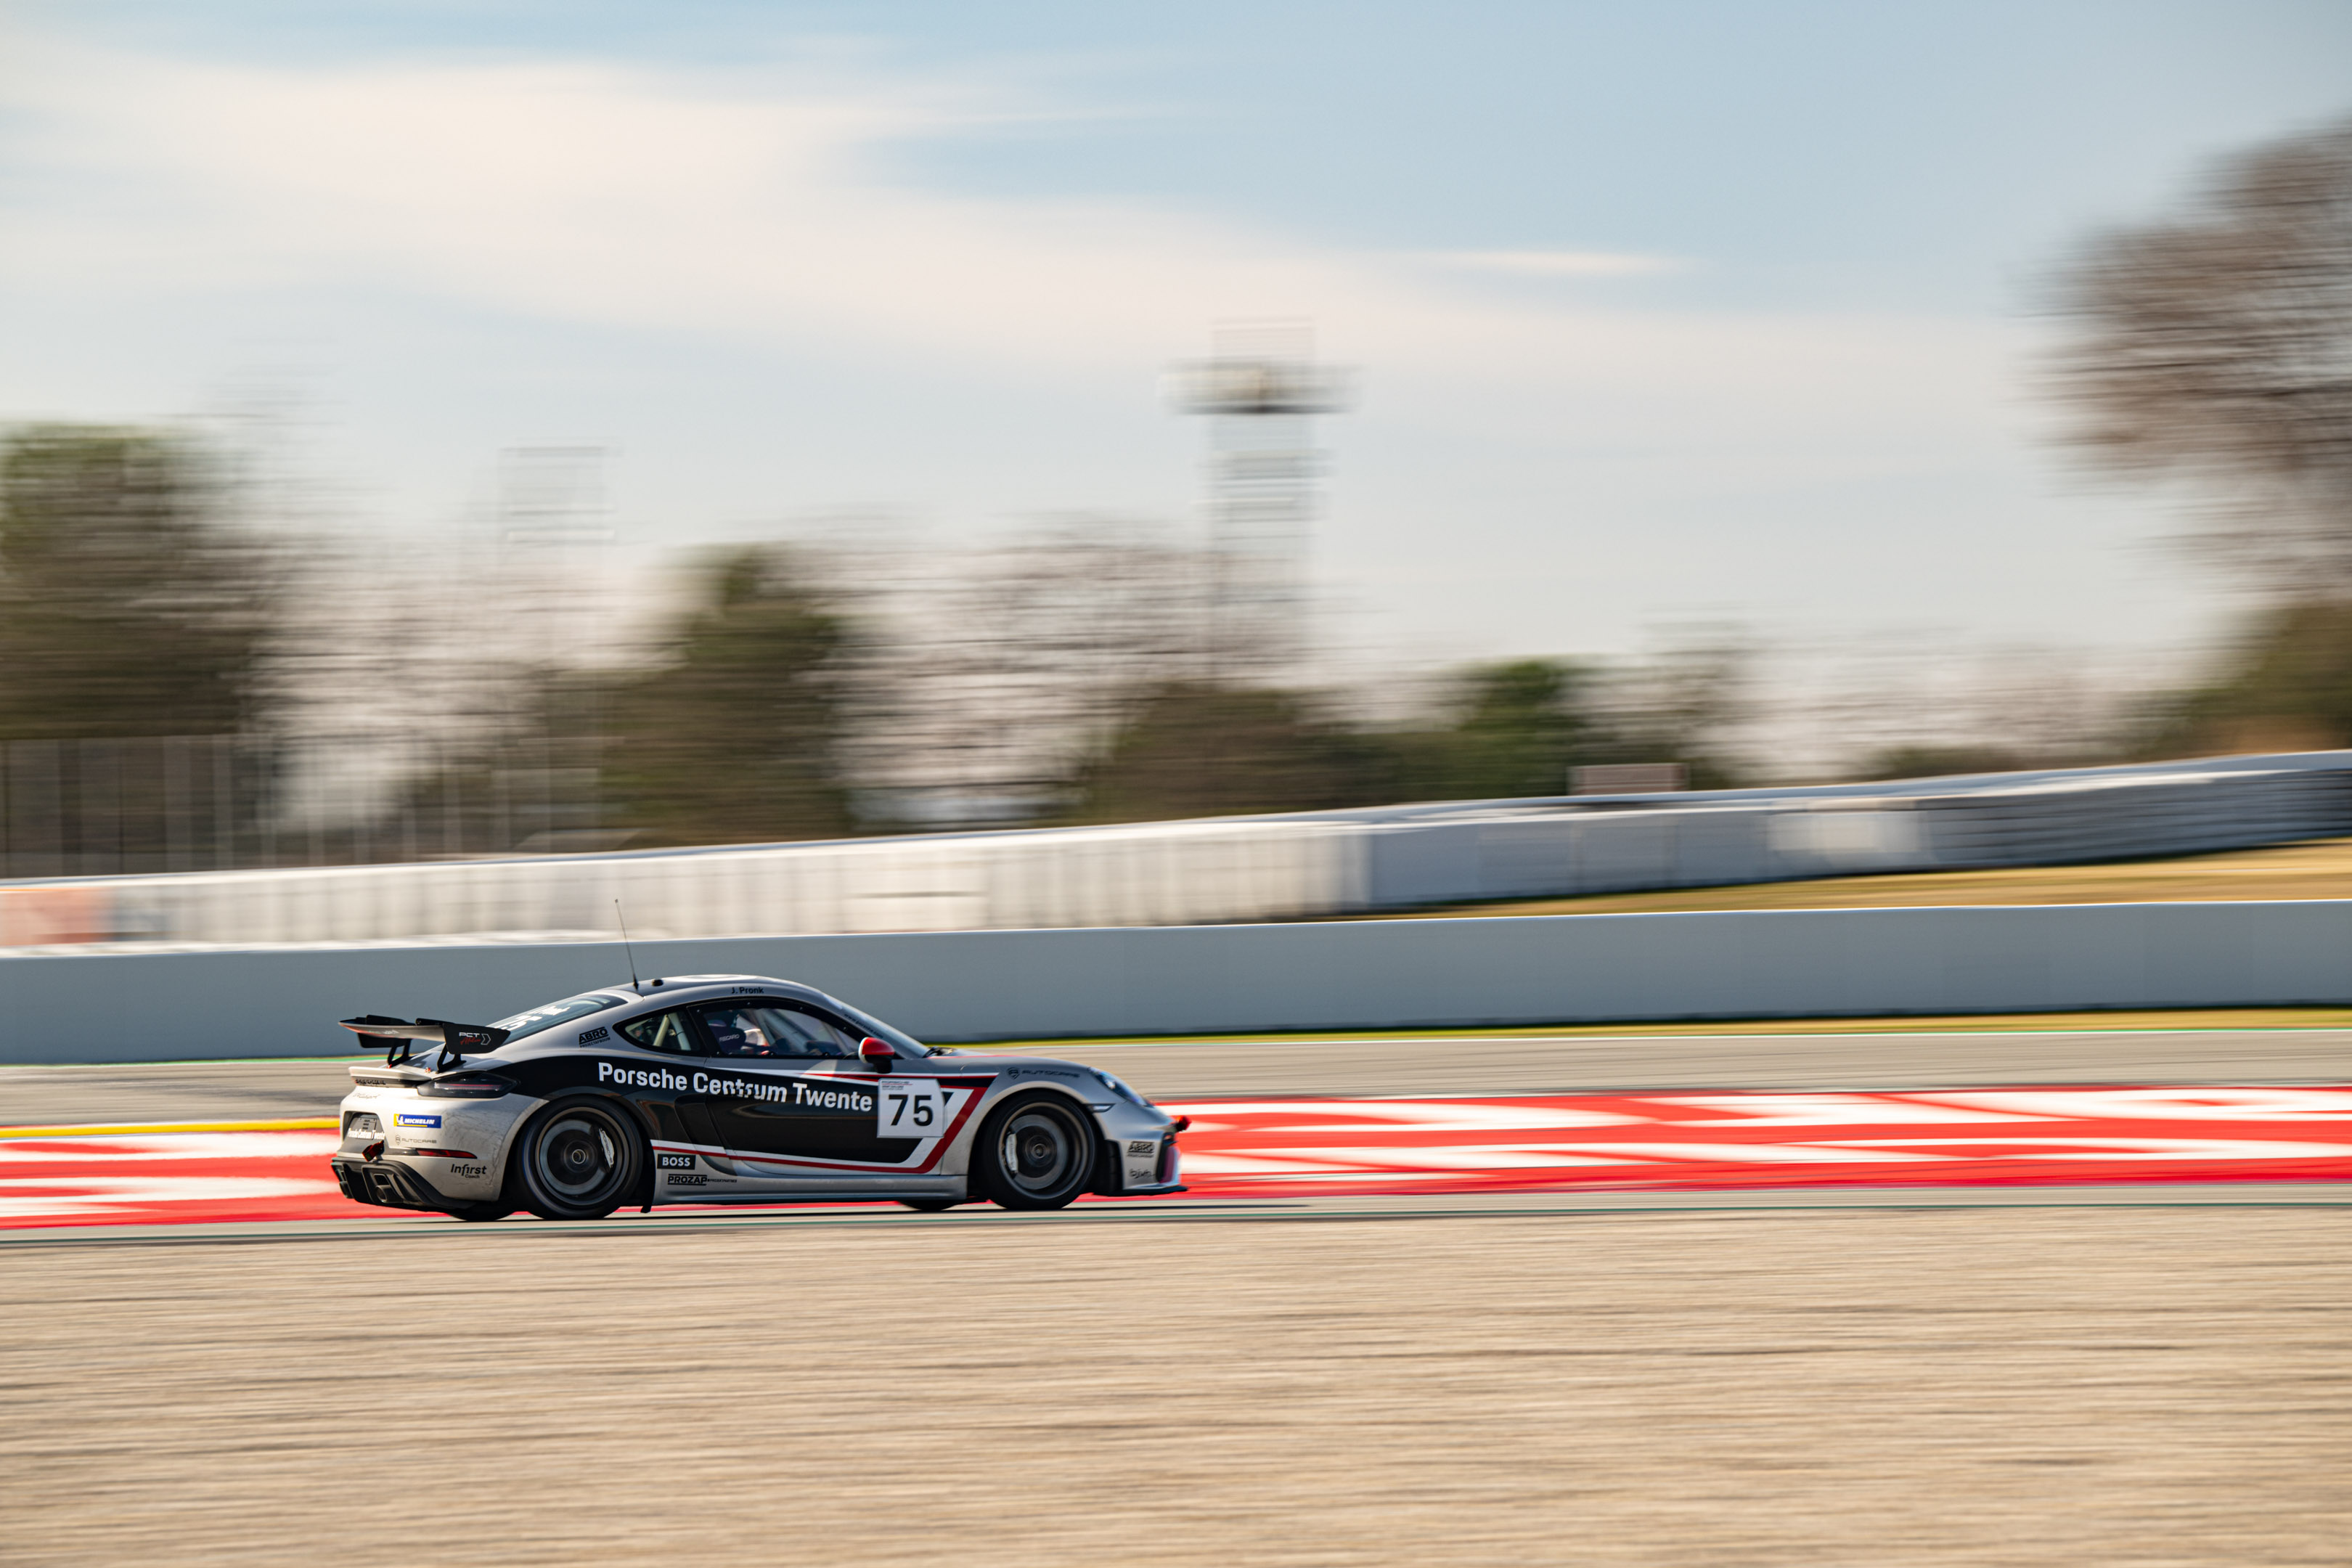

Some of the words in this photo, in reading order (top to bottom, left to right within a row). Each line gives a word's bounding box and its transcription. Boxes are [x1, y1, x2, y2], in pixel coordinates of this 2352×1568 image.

[579, 1028, 608, 1042] ABRO
[719, 1034, 740, 1042] RECARO
[598, 1062, 687, 1090] Porsche
[693, 1072, 787, 1103] Centrum
[793, 1082, 873, 1112] Twente
[888, 1094, 934, 1127] 75
[662, 1156, 691, 1167] BOSS
[450, 1164, 487, 1176] Infirst
